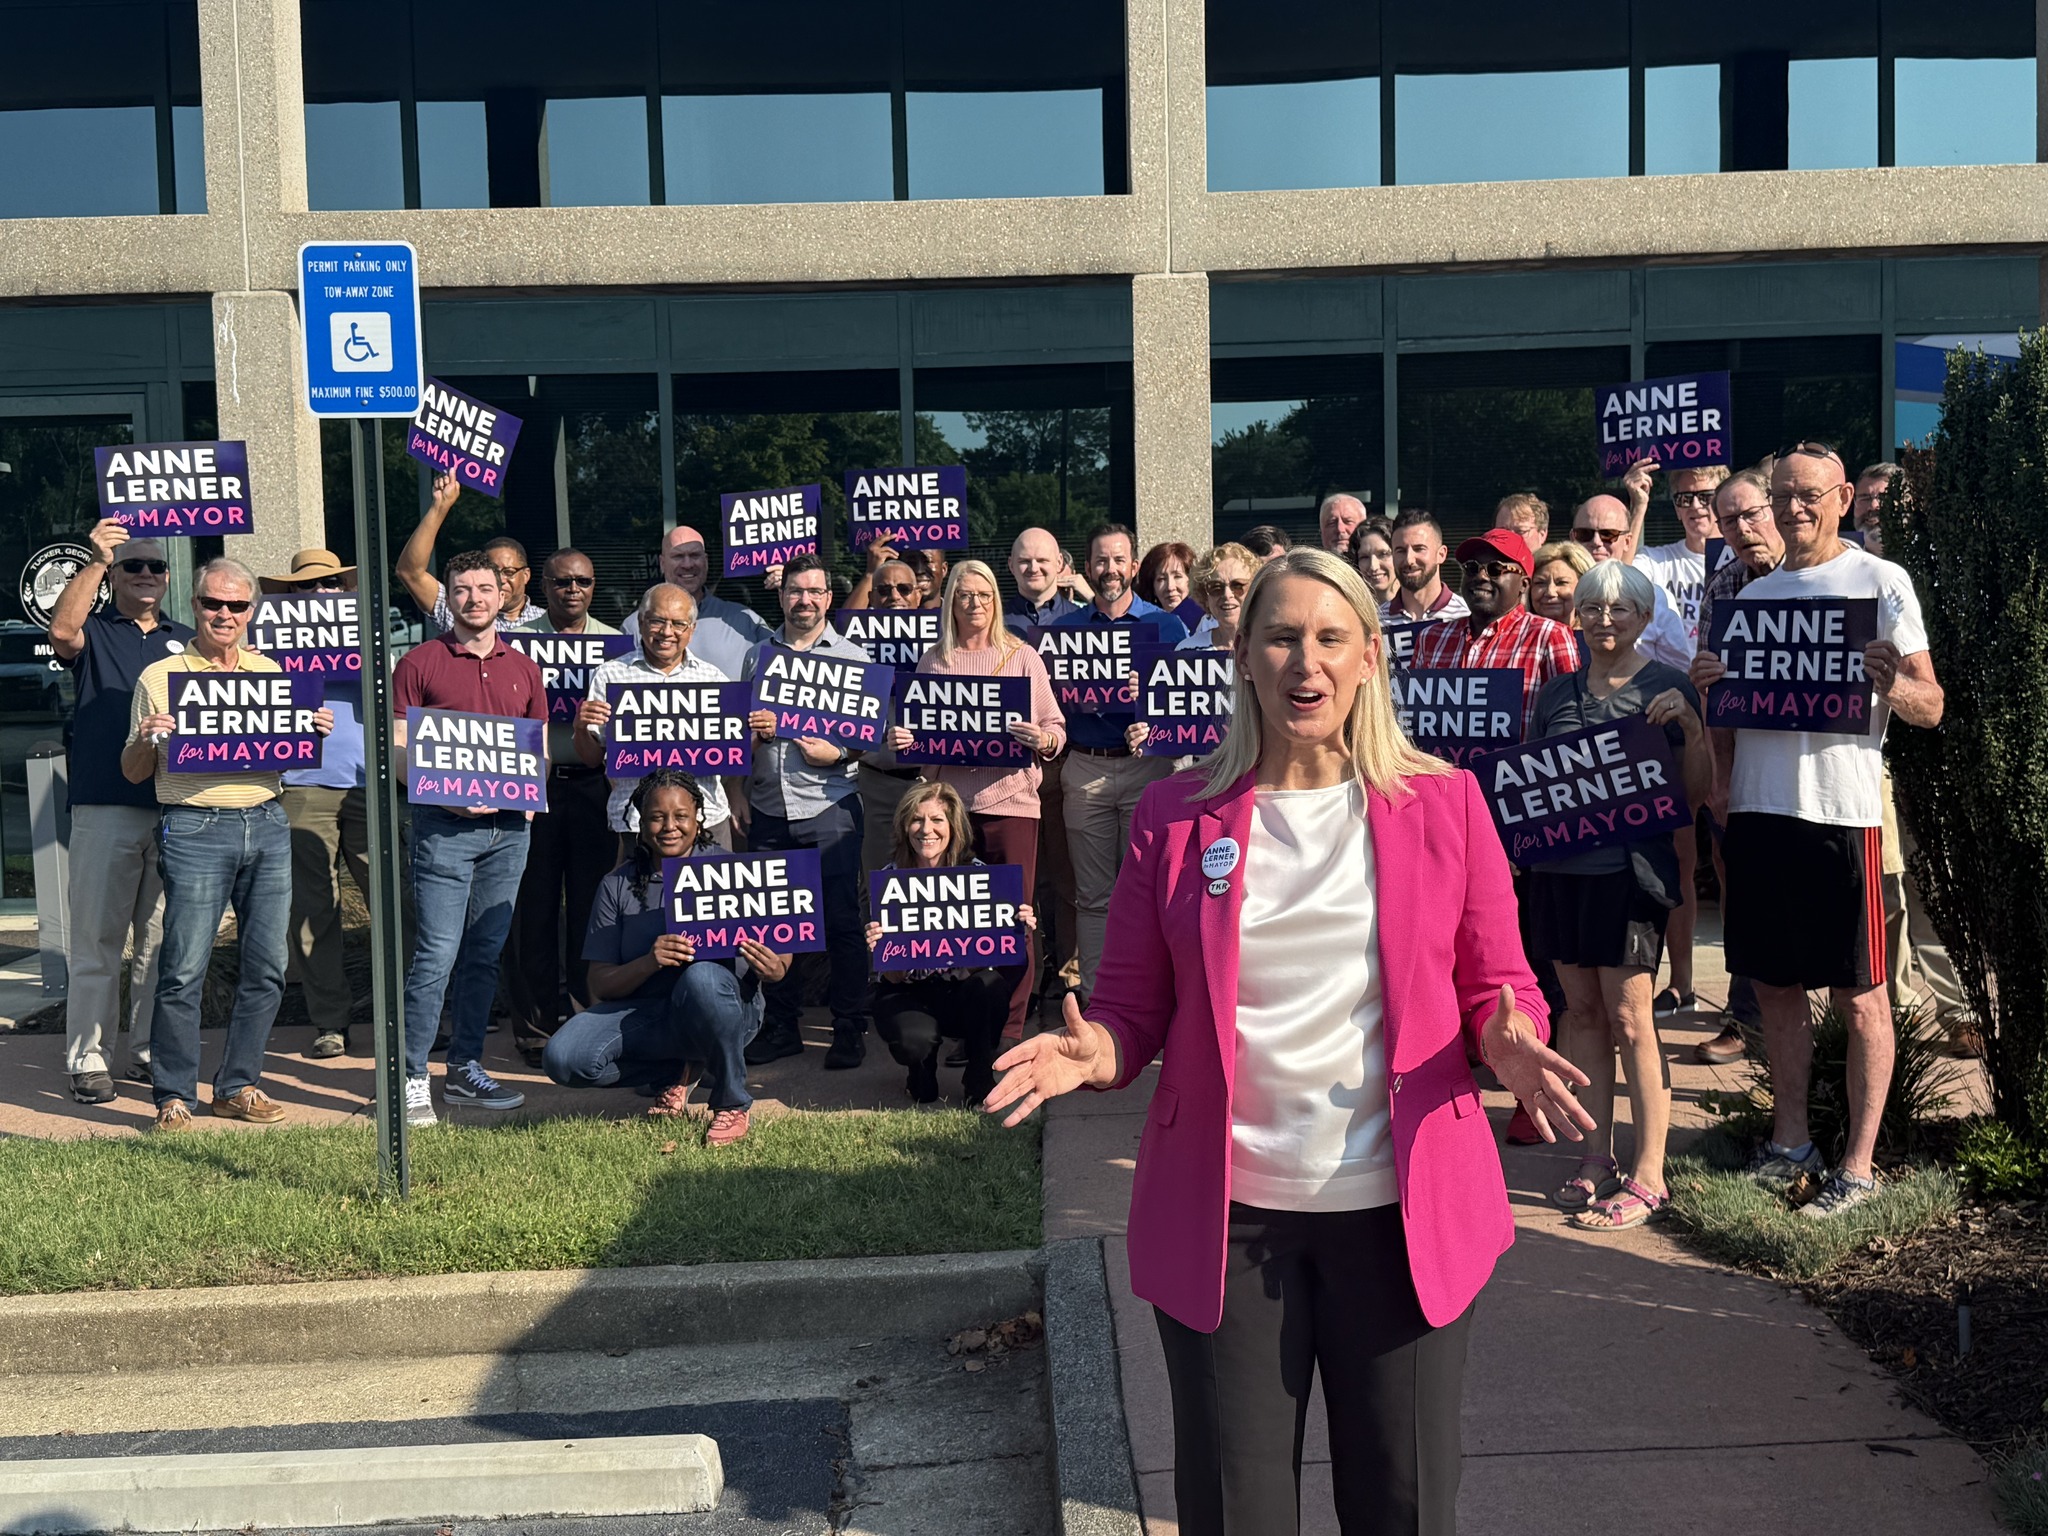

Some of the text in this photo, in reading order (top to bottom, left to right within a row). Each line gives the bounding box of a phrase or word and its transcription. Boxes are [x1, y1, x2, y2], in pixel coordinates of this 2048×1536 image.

[308, 260, 407, 272] PERMIT PARKING ONLY
[324, 286, 394, 298] TOW-AWAY ZONE
[311, 386, 416, 398] MAXIMUM FINE $500.00
[1603, 382, 1698, 418] ANNE
[423, 384, 497, 436] ANNE
[415, 412, 505, 466] LERNER
[1603, 408, 1721, 444] LERNER
[106, 448, 216, 478] ANNE
[412, 433, 497, 487] for MAYOR
[1605, 439, 1722, 470] for MAYOR
[107, 476, 242, 503] LERNER
[853, 473, 939, 498] ANNE
[138, 506, 245, 527] MAYOR
[730, 492, 804, 523] ANNE
[853, 498, 960, 521] LERNER
[730, 516, 817, 546] LERNER
[856, 528, 873, 545] for
[30, 547, 91, 571] TUCKER, GEOR
[730, 552, 750, 570] for
[256, 599, 358, 625] ANNE
[256, 625, 360, 650] LERNE
[845, 615, 938, 639] ANNE
[1722, 610, 1845, 644] ANNE
[1038, 631, 1131, 655] ANNE
[285, 653, 362, 672] MAYO
[764, 654, 864, 691] ANNE
[1049, 658, 1131, 680] ERNE
[1148, 659, 1233, 687] ANN
[1720, 649, 1866, 683] LERNER
[178, 679, 292, 706] ANNE
[615, 689, 721, 715] ANNE
[760, 679, 880, 719] LERNER
[904, 680, 1001, 707] ANNE
[1062, 686, 1132, 703] MAYO
[1147, 691, 1236, 716] LERN
[1717, 689, 1863, 720] for MAYOR
[178, 709, 315, 735] LERNER
[416, 715, 516, 749] ANNE
[615, 717, 743, 742] LERNER
[780, 711, 875, 742] MAYOR
[1398, 711, 1511, 737] ERNER
[929, 738, 1023, 758] MAYOR
[1147, 725, 1173, 747] for
[177, 741, 314, 765] for MAYOR
[416, 744, 538, 777] LERNER
[615, 748, 743, 770] for MAYOR
[1494, 730, 1626, 793] ANNE
[416, 775, 540, 802] for MAYOR
[1497, 759, 1668, 825] LERNER
[1513, 796, 1677, 858] for MAYOR
[1204, 853, 1235, 862] LERNER
[1206, 846, 1231, 855] ANNE
[674, 859, 788, 893] ANNE
[880, 873, 991, 905] ANNE
[1211, 883, 1228, 891] TKR
[674, 889, 814, 922] LERNER
[881, 903, 1015, 933] LERNER
[706, 922, 816, 948] MAYOR
[882, 935, 1017, 963] for MAYOR
